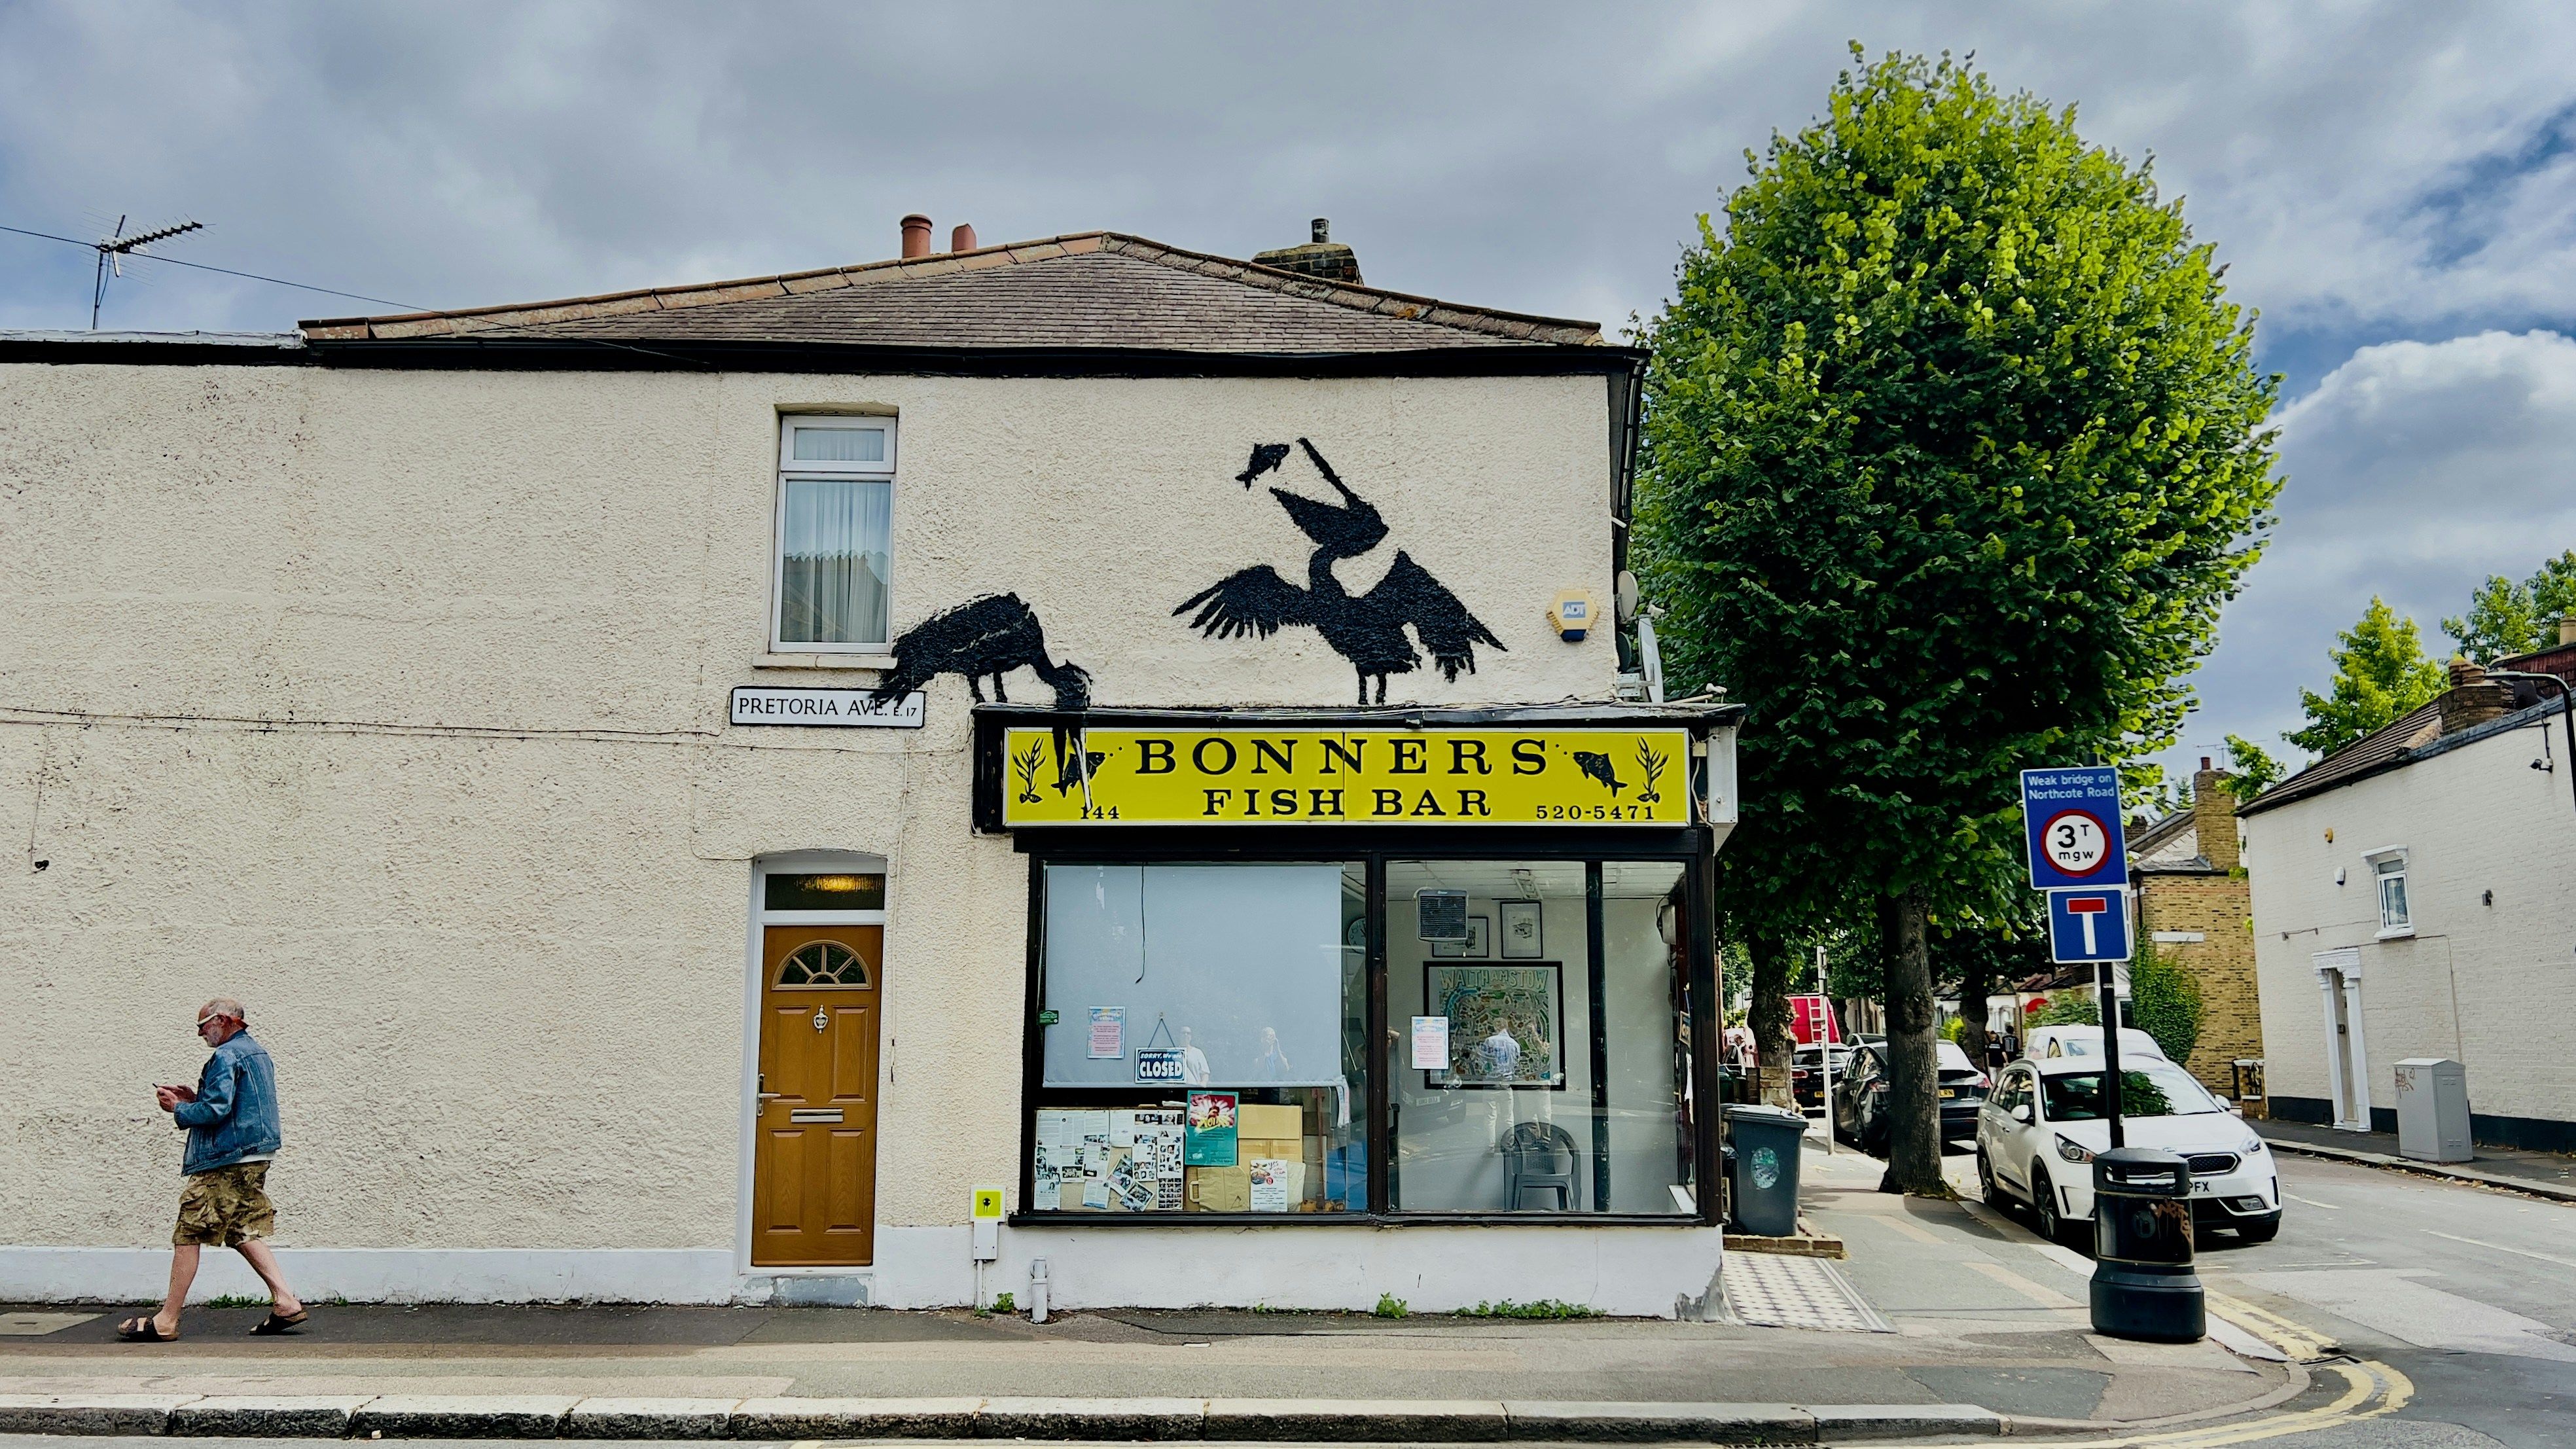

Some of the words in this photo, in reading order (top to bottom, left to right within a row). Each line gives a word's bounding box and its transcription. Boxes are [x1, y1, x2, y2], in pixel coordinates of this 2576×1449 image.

[1562, 604, 1585, 615] ADT
[739, 698, 838, 715] PRETORIA
[1135, 738, 1547, 775] BONNERS
[2028, 775, 2058, 786] Weak
[2060, 774, 2094, 786] bridge
[2098, 774, 2112, 783] on
[2028, 788, 2083, 800] Northcote
[2086, 787, 2115, 797] Road
[1202, 789, 1344, 816] FISH
[1372, 789, 1491, 816] BAR
[1081, 805, 1119, 819] 144
[1536, 805, 1654, 819] 520-5471
[2058, 850, 2094, 862] mgw
[1440, 969, 1548, 991] WALTHAMSTOW
[1139, 1061, 1183, 1077] CLOSED
